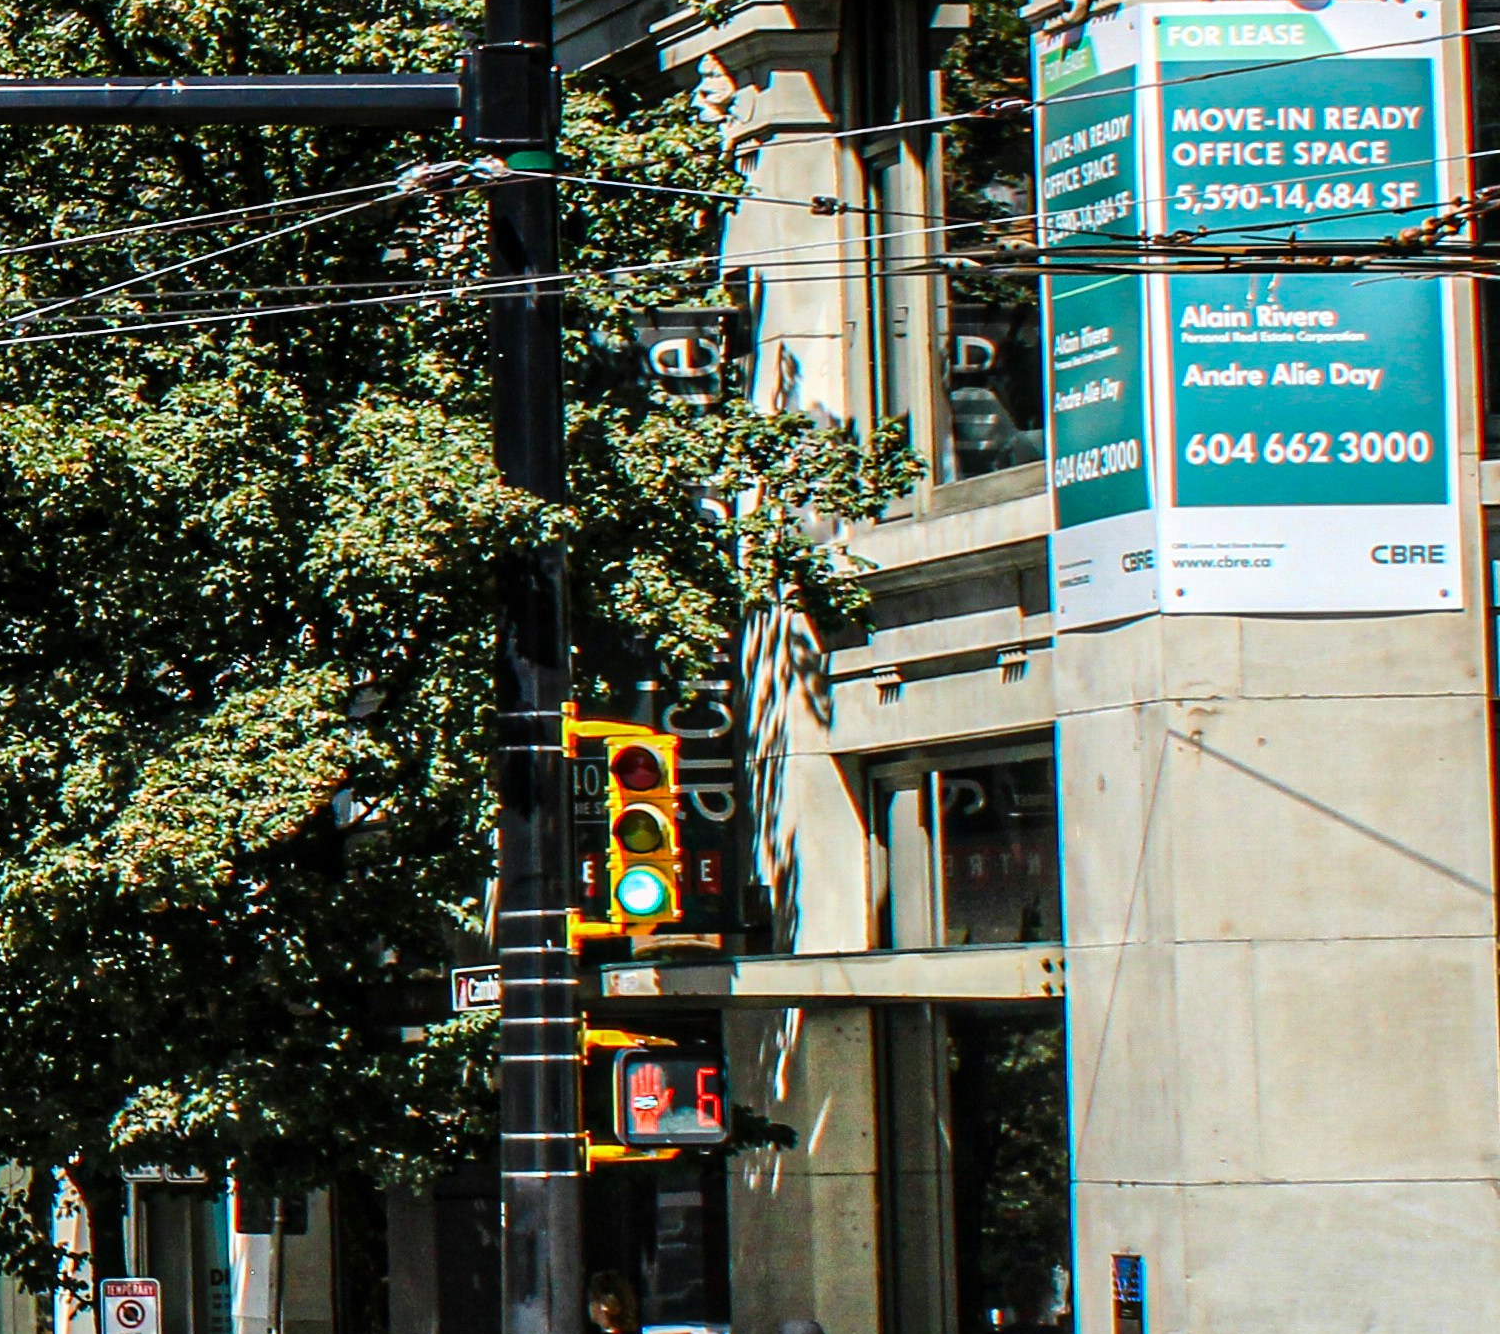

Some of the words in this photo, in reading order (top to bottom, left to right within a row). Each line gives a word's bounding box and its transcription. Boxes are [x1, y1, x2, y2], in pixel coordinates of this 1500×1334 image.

[1167, 25, 1221, 47] FOR
[1229, 24, 1306, 46] LEASE
[1172, 107, 1314, 131] MOVE-IN
[1324, 106, 1422, 130] READY
[1044, 129, 1088, 166] MOVE-IN
[1089, 114, 1132, 149] READY
[1172, 142, 1285, 167] OFFICE
[1293, 141, 1389, 165] SPACE
[1044, 166, 1081, 200] OFFICE
[1082, 153, 1120, 187] SPACE
[1174, 182, 1373, 214] 5,590-14,684
[1381, 182, 1421, 209] SF
[1180, 305, 1251, 329] Alain
[1256, 304, 1338, 327] Rivere
[1181, 332, 1231, 343] Personal
[1233, 332, 1258, 343] Real
[1260, 332, 1295, 343] Estate
[1297, 331, 1367, 344] Corporation
[1182, 363, 1266, 387] Andre
[1271, 362, 1323, 386] Alie
[1329, 362, 1383, 390] Day
[1185, 432, 1257, 465] 604
[1263, 432, 1333, 464] 662
[1337, 431, 1433, 463] 3000
[1055, 455, 1077, 488] 604
[1077, 448, 1101, 481] 662
[1101, 439, 1141, 475] 3000
[1122, 549, 1153, 573] CBRE
[1172, 554, 1272, 569] www.cbre.ca
[1370, 544, 1446, 565] CBRE
[468, 973, 501, 1002] Cambi
[697, 1068, 722, 1127] 6
[106, 1282, 154, 1296] TEMPORARY
